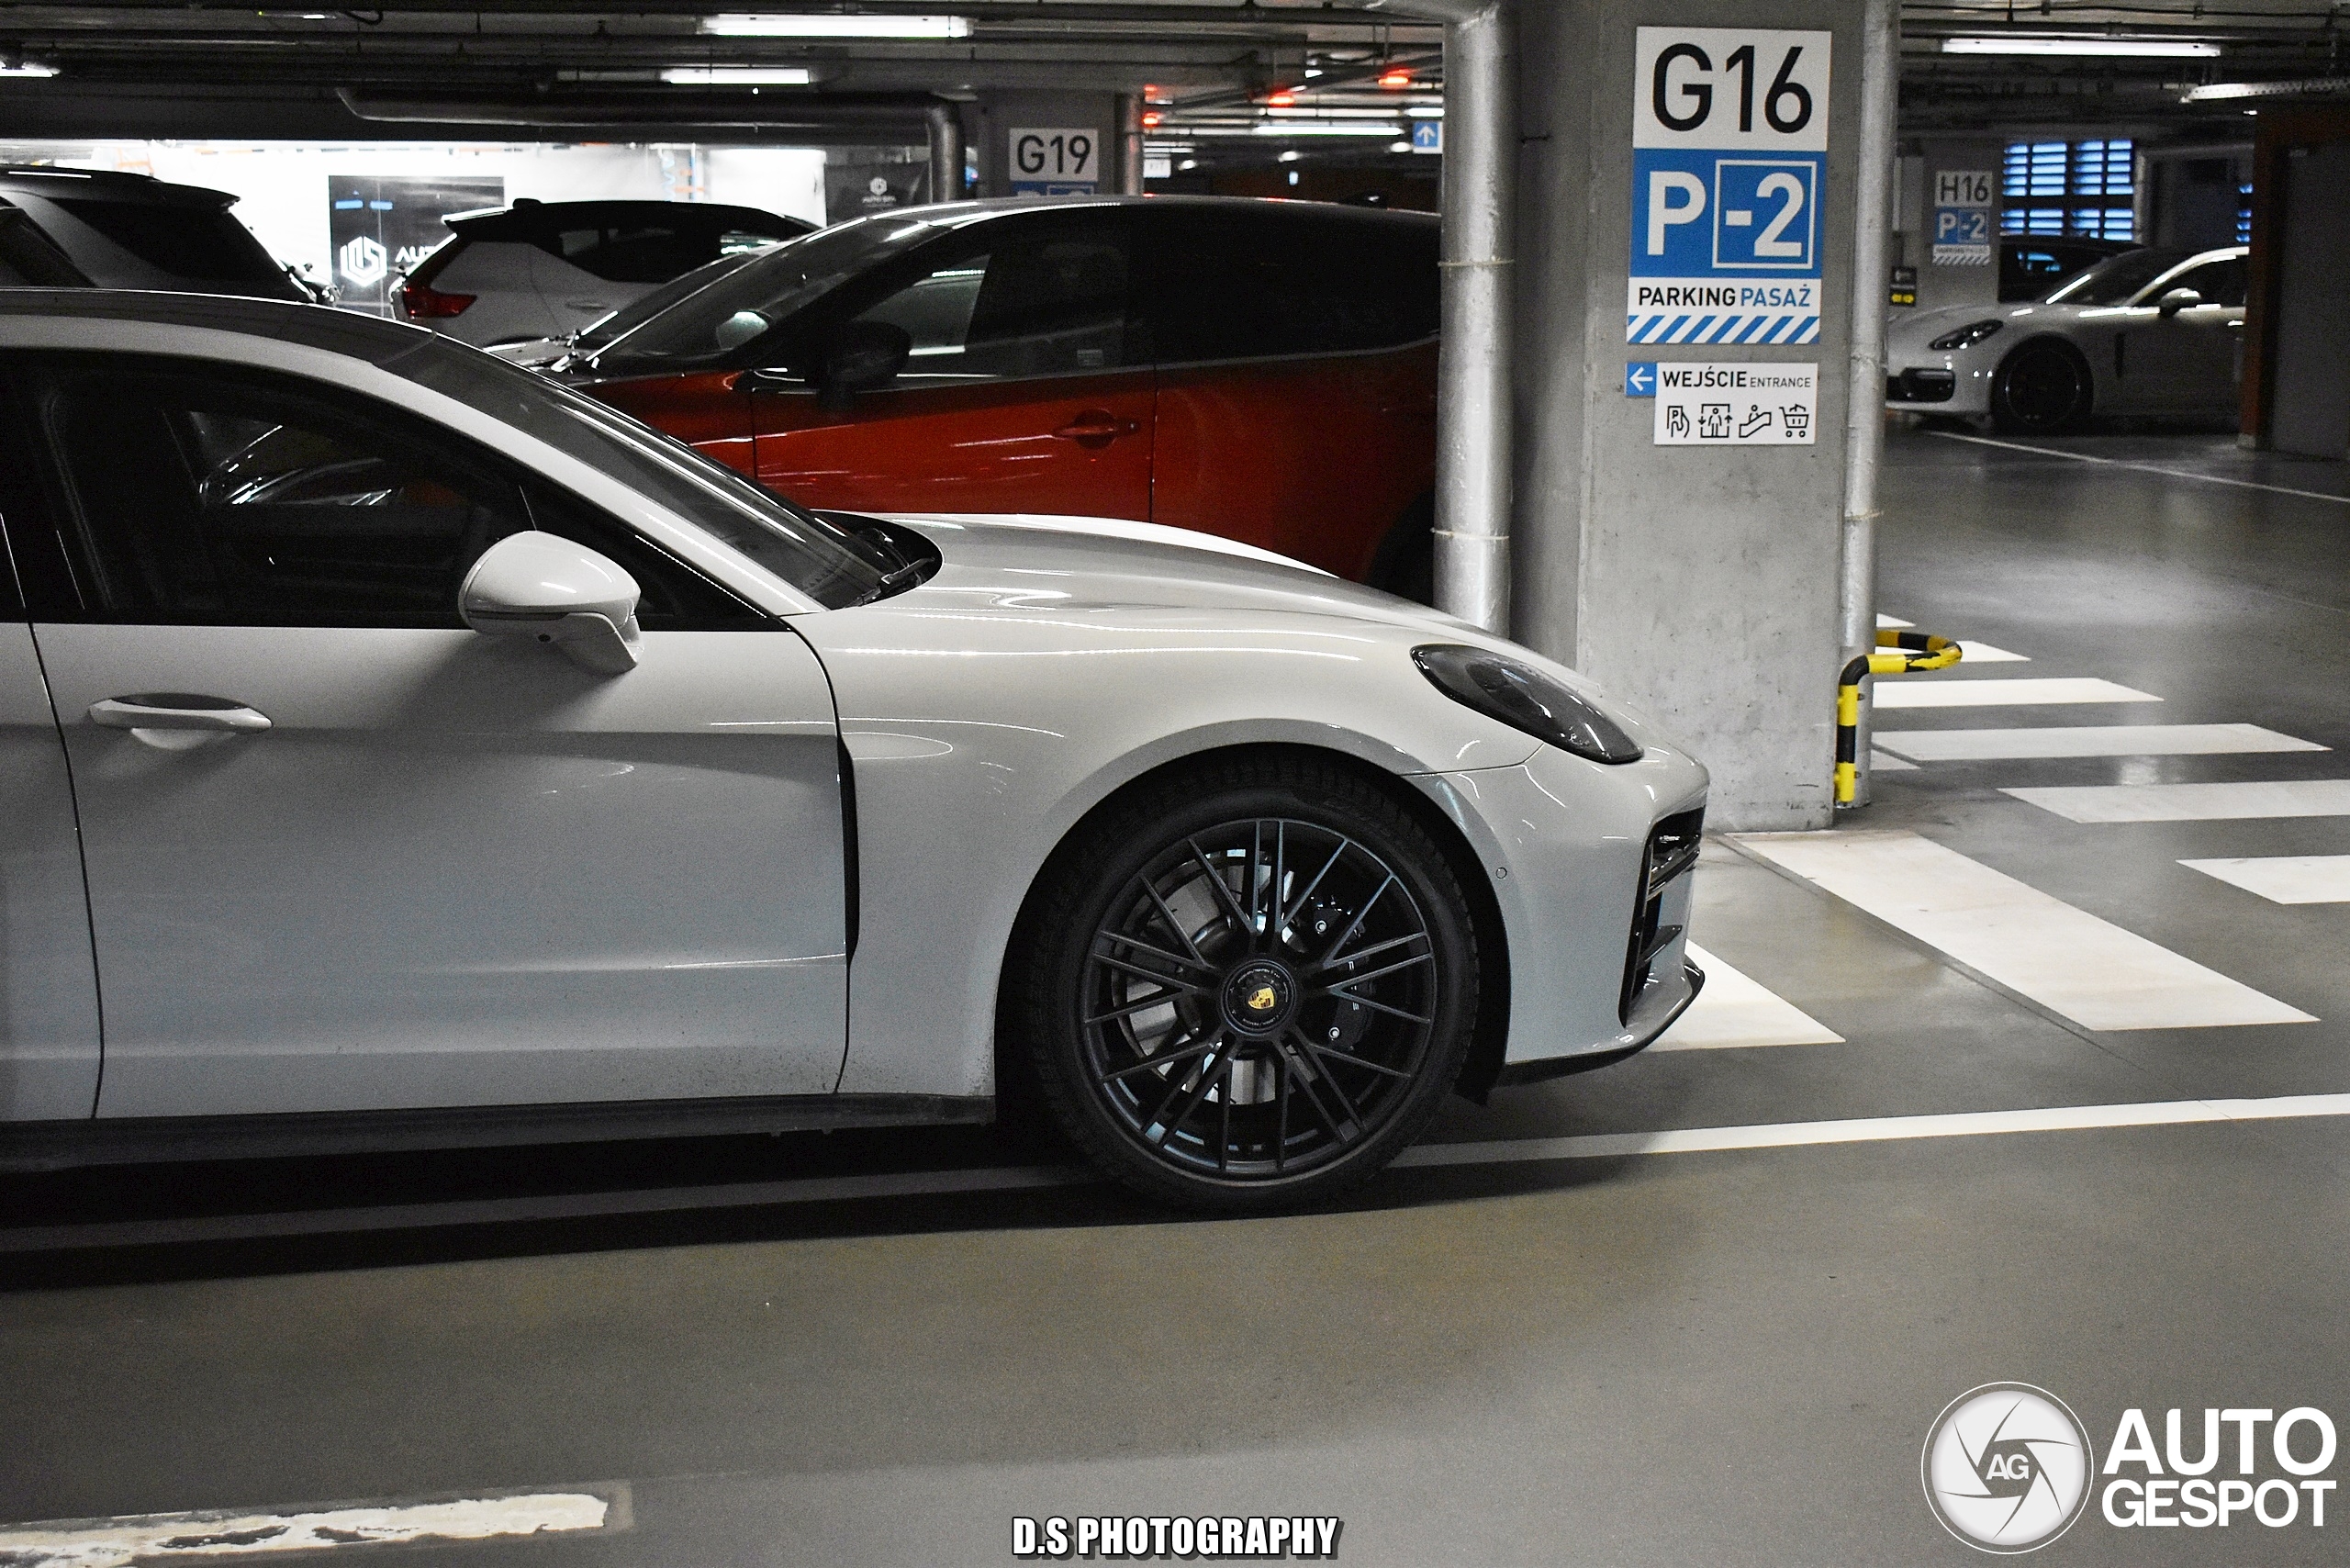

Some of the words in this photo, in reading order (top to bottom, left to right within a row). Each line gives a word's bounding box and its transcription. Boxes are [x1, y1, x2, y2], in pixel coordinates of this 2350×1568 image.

[1653, 43, 1812, 134] G16
[1017, 135, 1091, 174] G19
[1941, 175, 1988, 202] H16
[1639, 287, 1736, 307] PARKING
[1740, 284, 1811, 308] PASAŻ
[1662, 365, 1747, 387] WEJŚCIE
[1750, 377, 1811, 388] ENTRANCE
